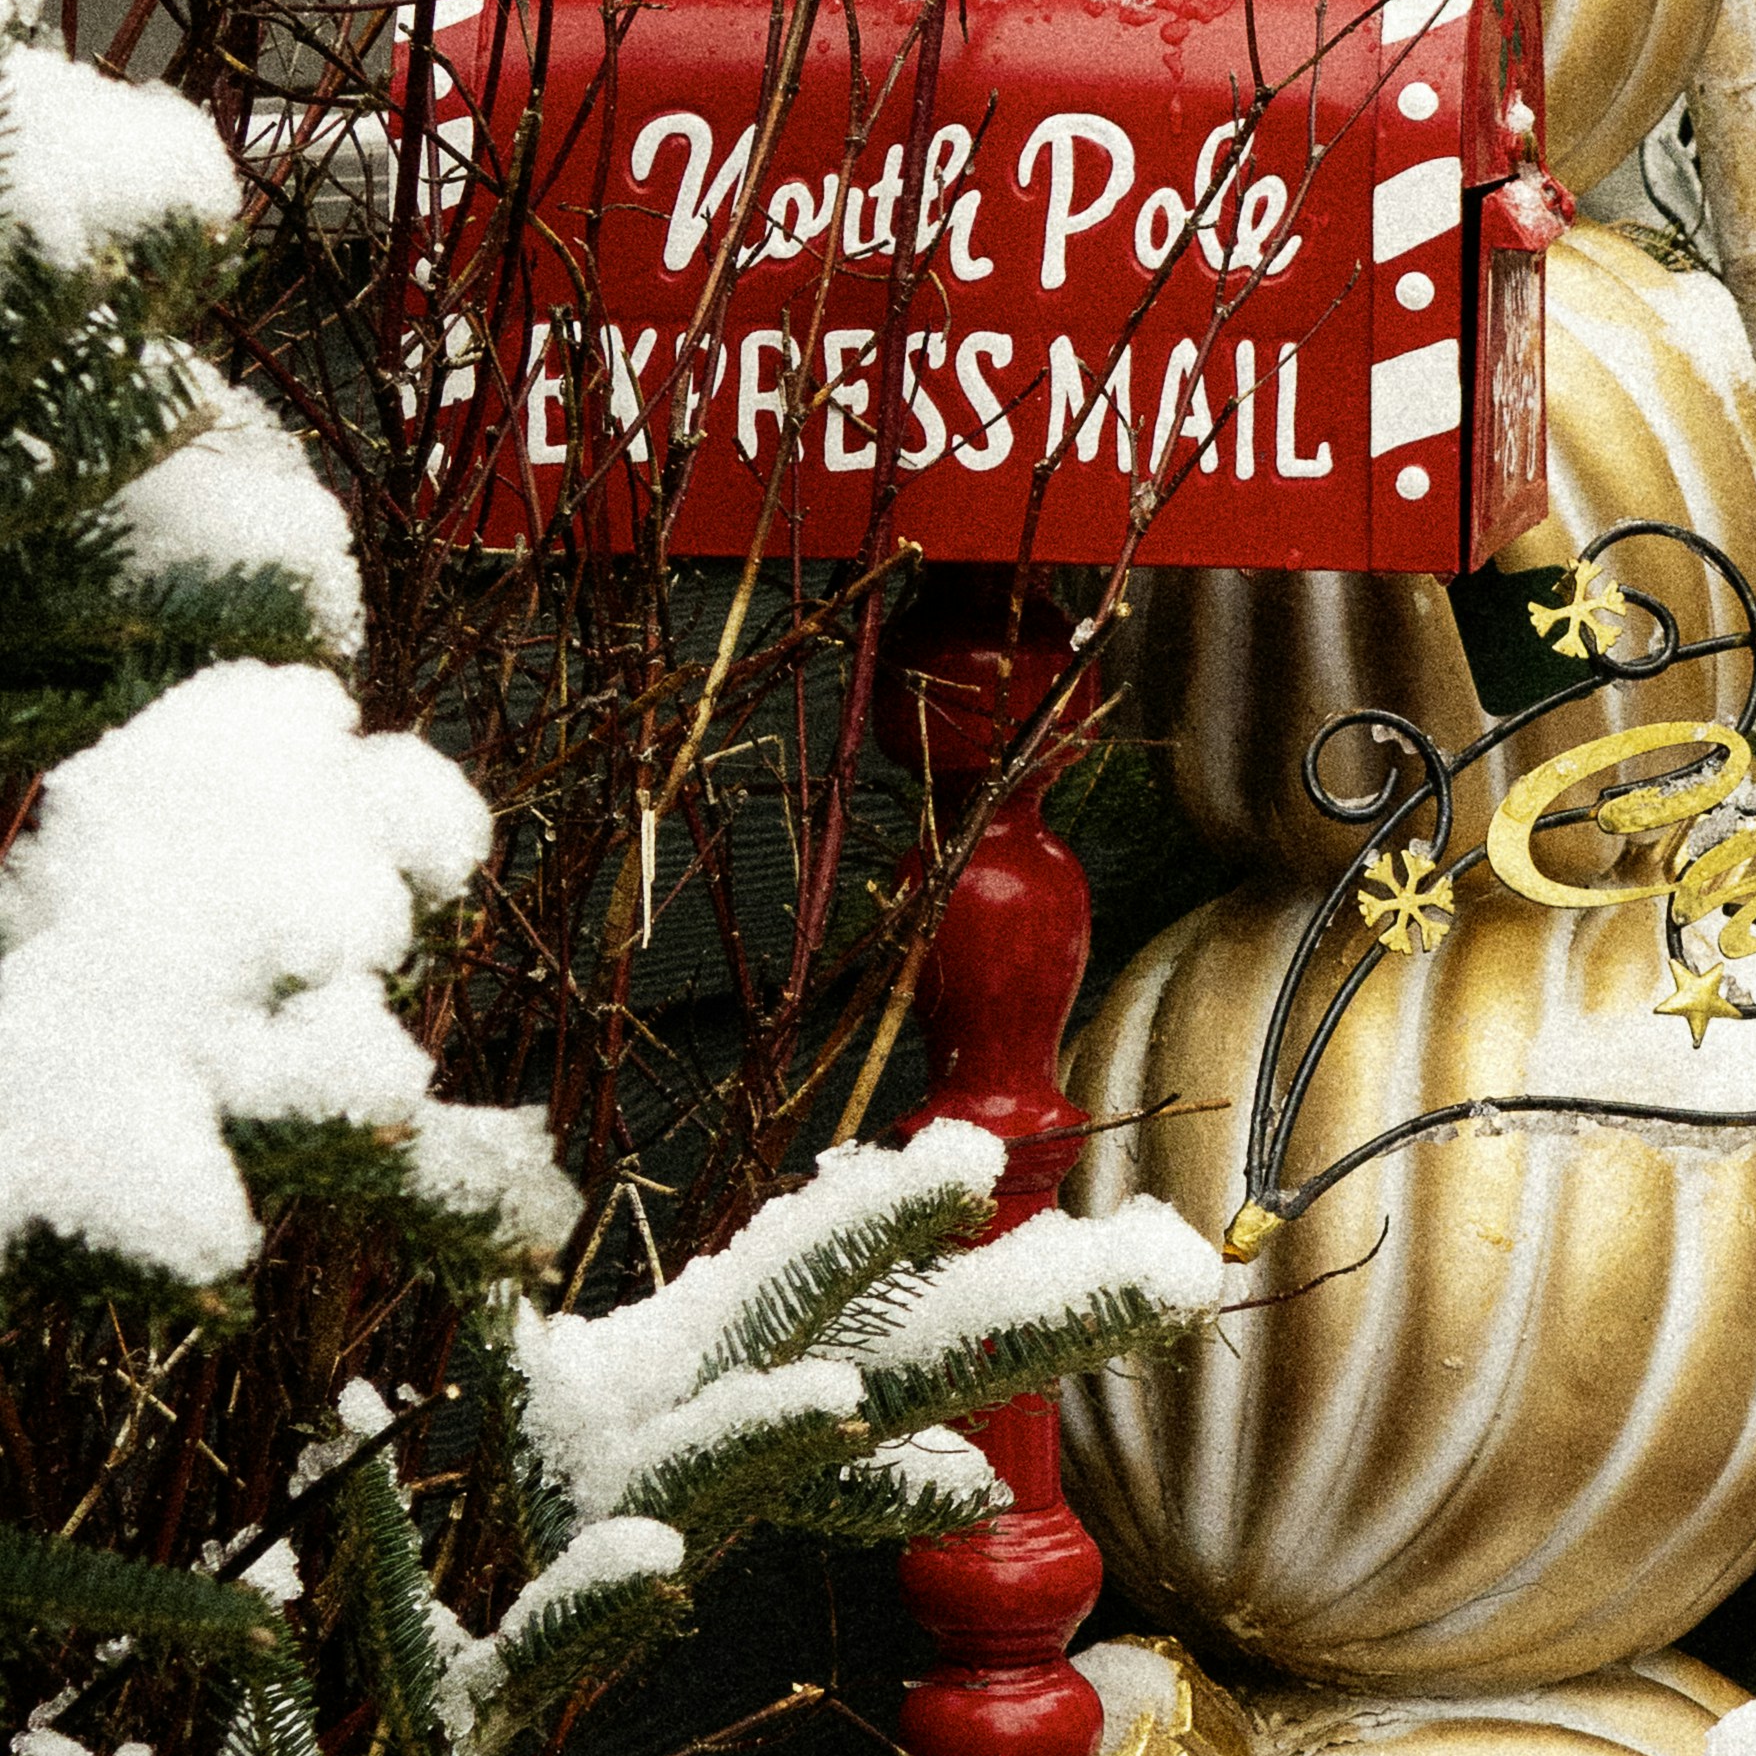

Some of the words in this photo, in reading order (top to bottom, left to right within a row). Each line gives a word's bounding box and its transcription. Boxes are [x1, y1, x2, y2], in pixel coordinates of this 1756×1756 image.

[631, 111, 994, 281] North
[1017, 112, 1303, 290] Pole
[526, 320, 1014, 472] EXPRESS
[1044, 333, 1334, 481] MAIL
